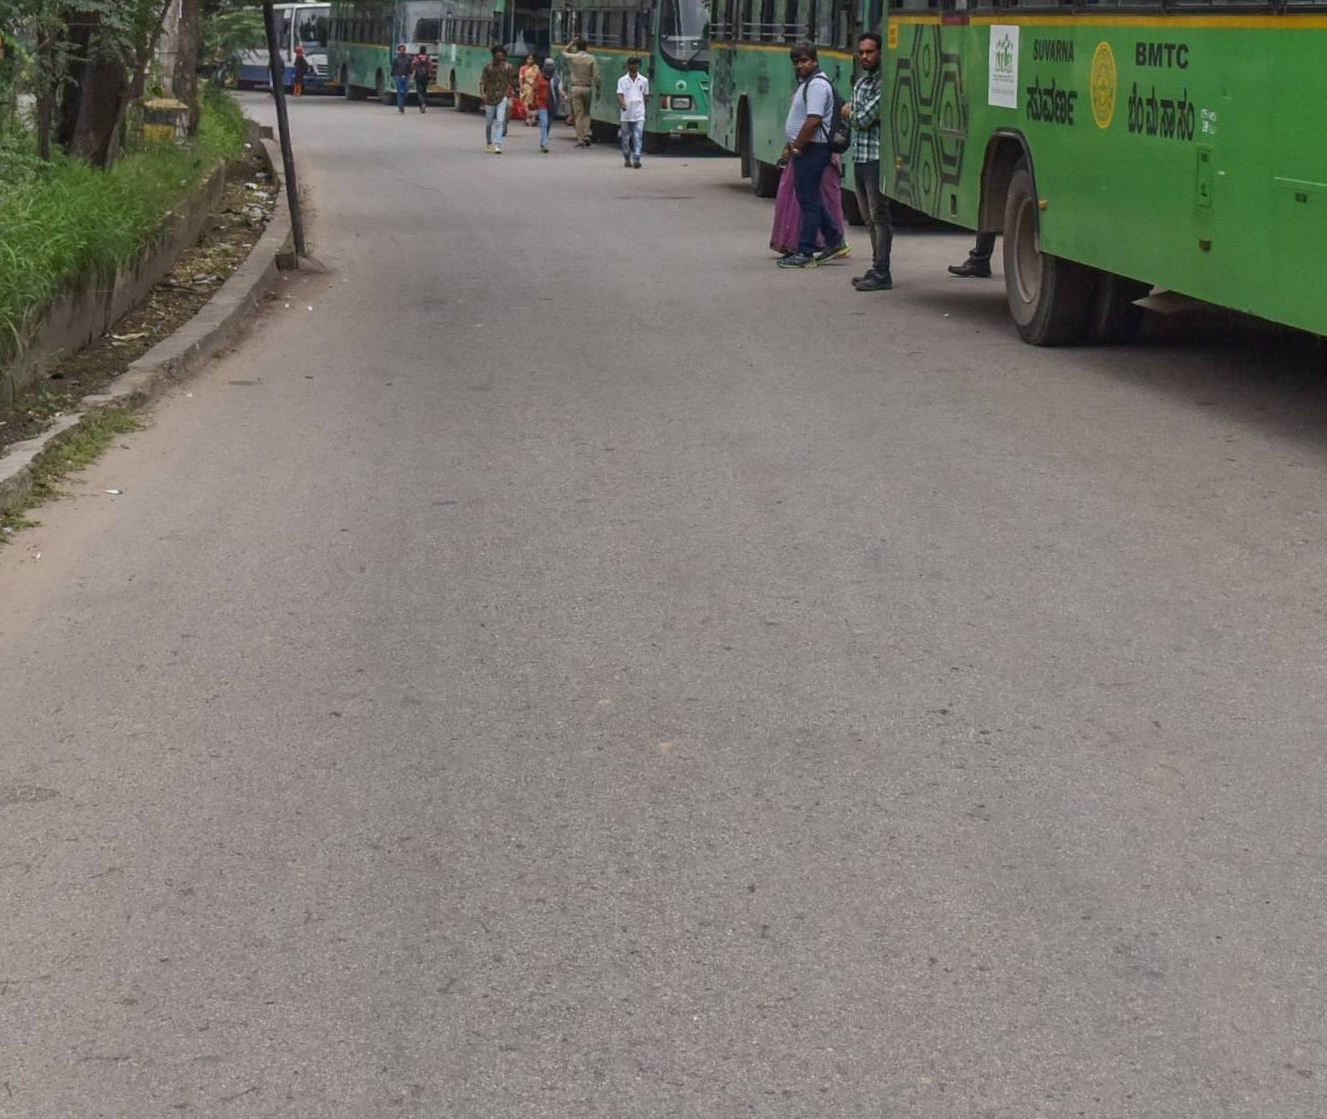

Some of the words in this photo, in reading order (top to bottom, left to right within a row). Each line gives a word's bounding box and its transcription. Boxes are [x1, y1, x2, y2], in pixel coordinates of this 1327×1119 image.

[1033, 38, 1074, 62] SUVARNA
[1135, 42, 1189, 69] BMTC
[1026, 74, 1078, 125] ಸುವರ್ಣ
